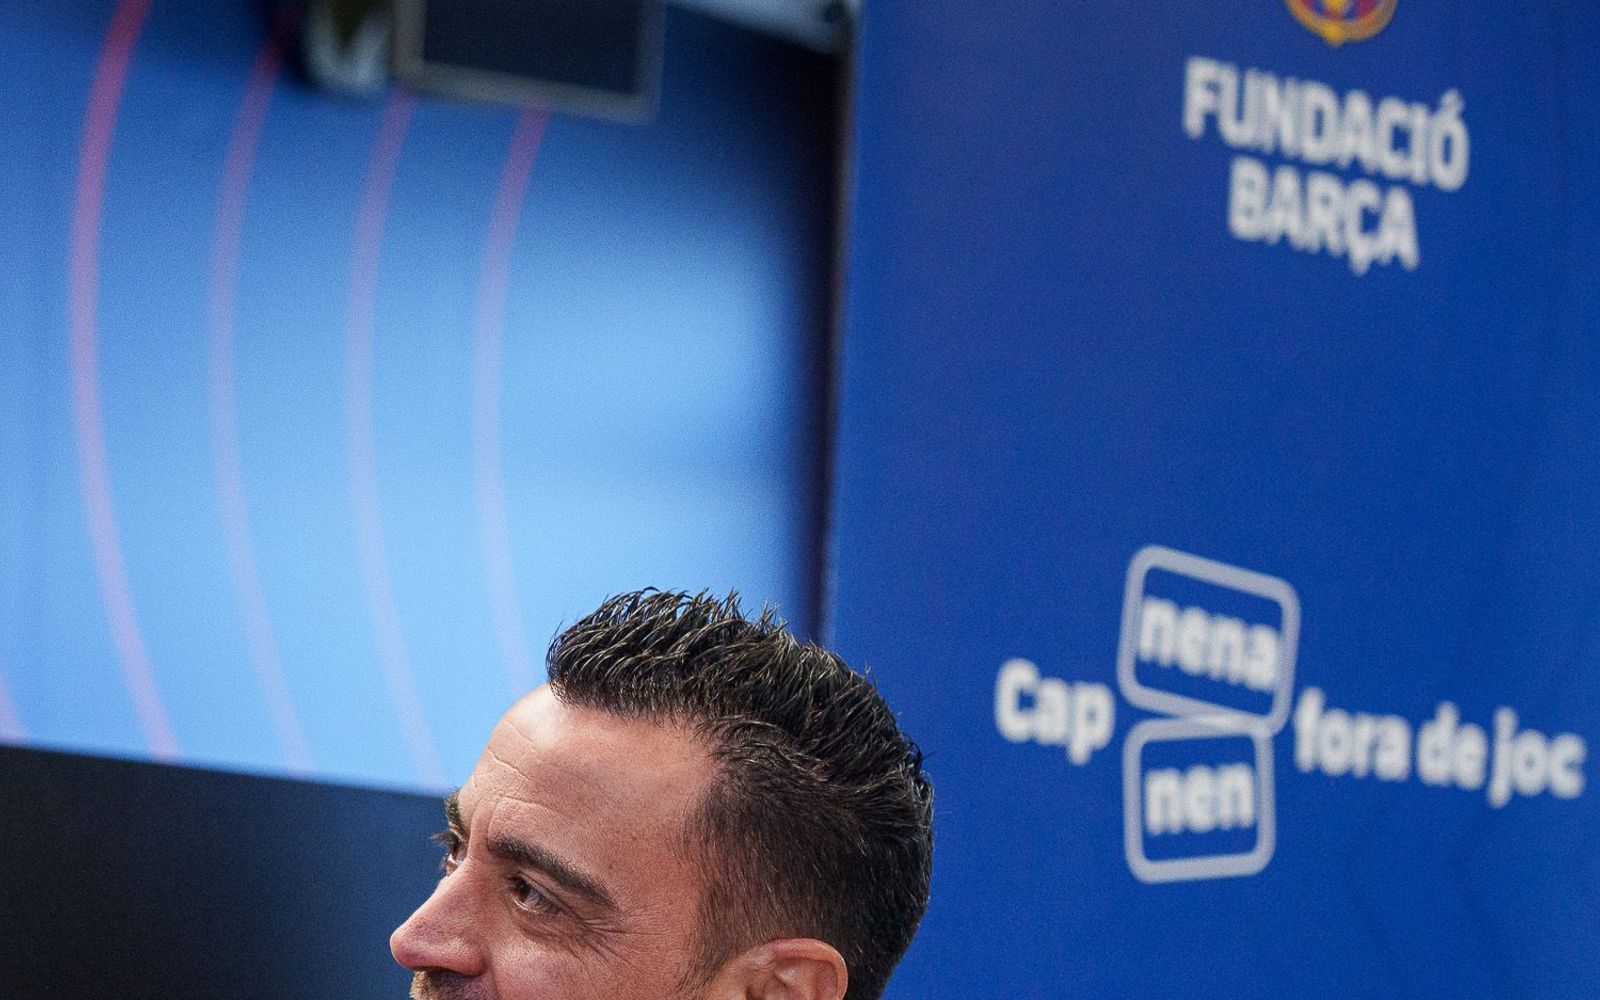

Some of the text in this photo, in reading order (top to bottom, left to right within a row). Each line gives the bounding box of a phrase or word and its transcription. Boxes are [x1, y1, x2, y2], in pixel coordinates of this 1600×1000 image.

[1183, 56, 1470, 192] FUNDACIÓ
[1228, 155, 1419, 276] BARÇA
[1137, 596, 1282, 693] nena
[994, 658, 1115, 766] Cap
[1294, 686, 1588, 808] fora de joc
[1143, 763, 1256, 836] nen
